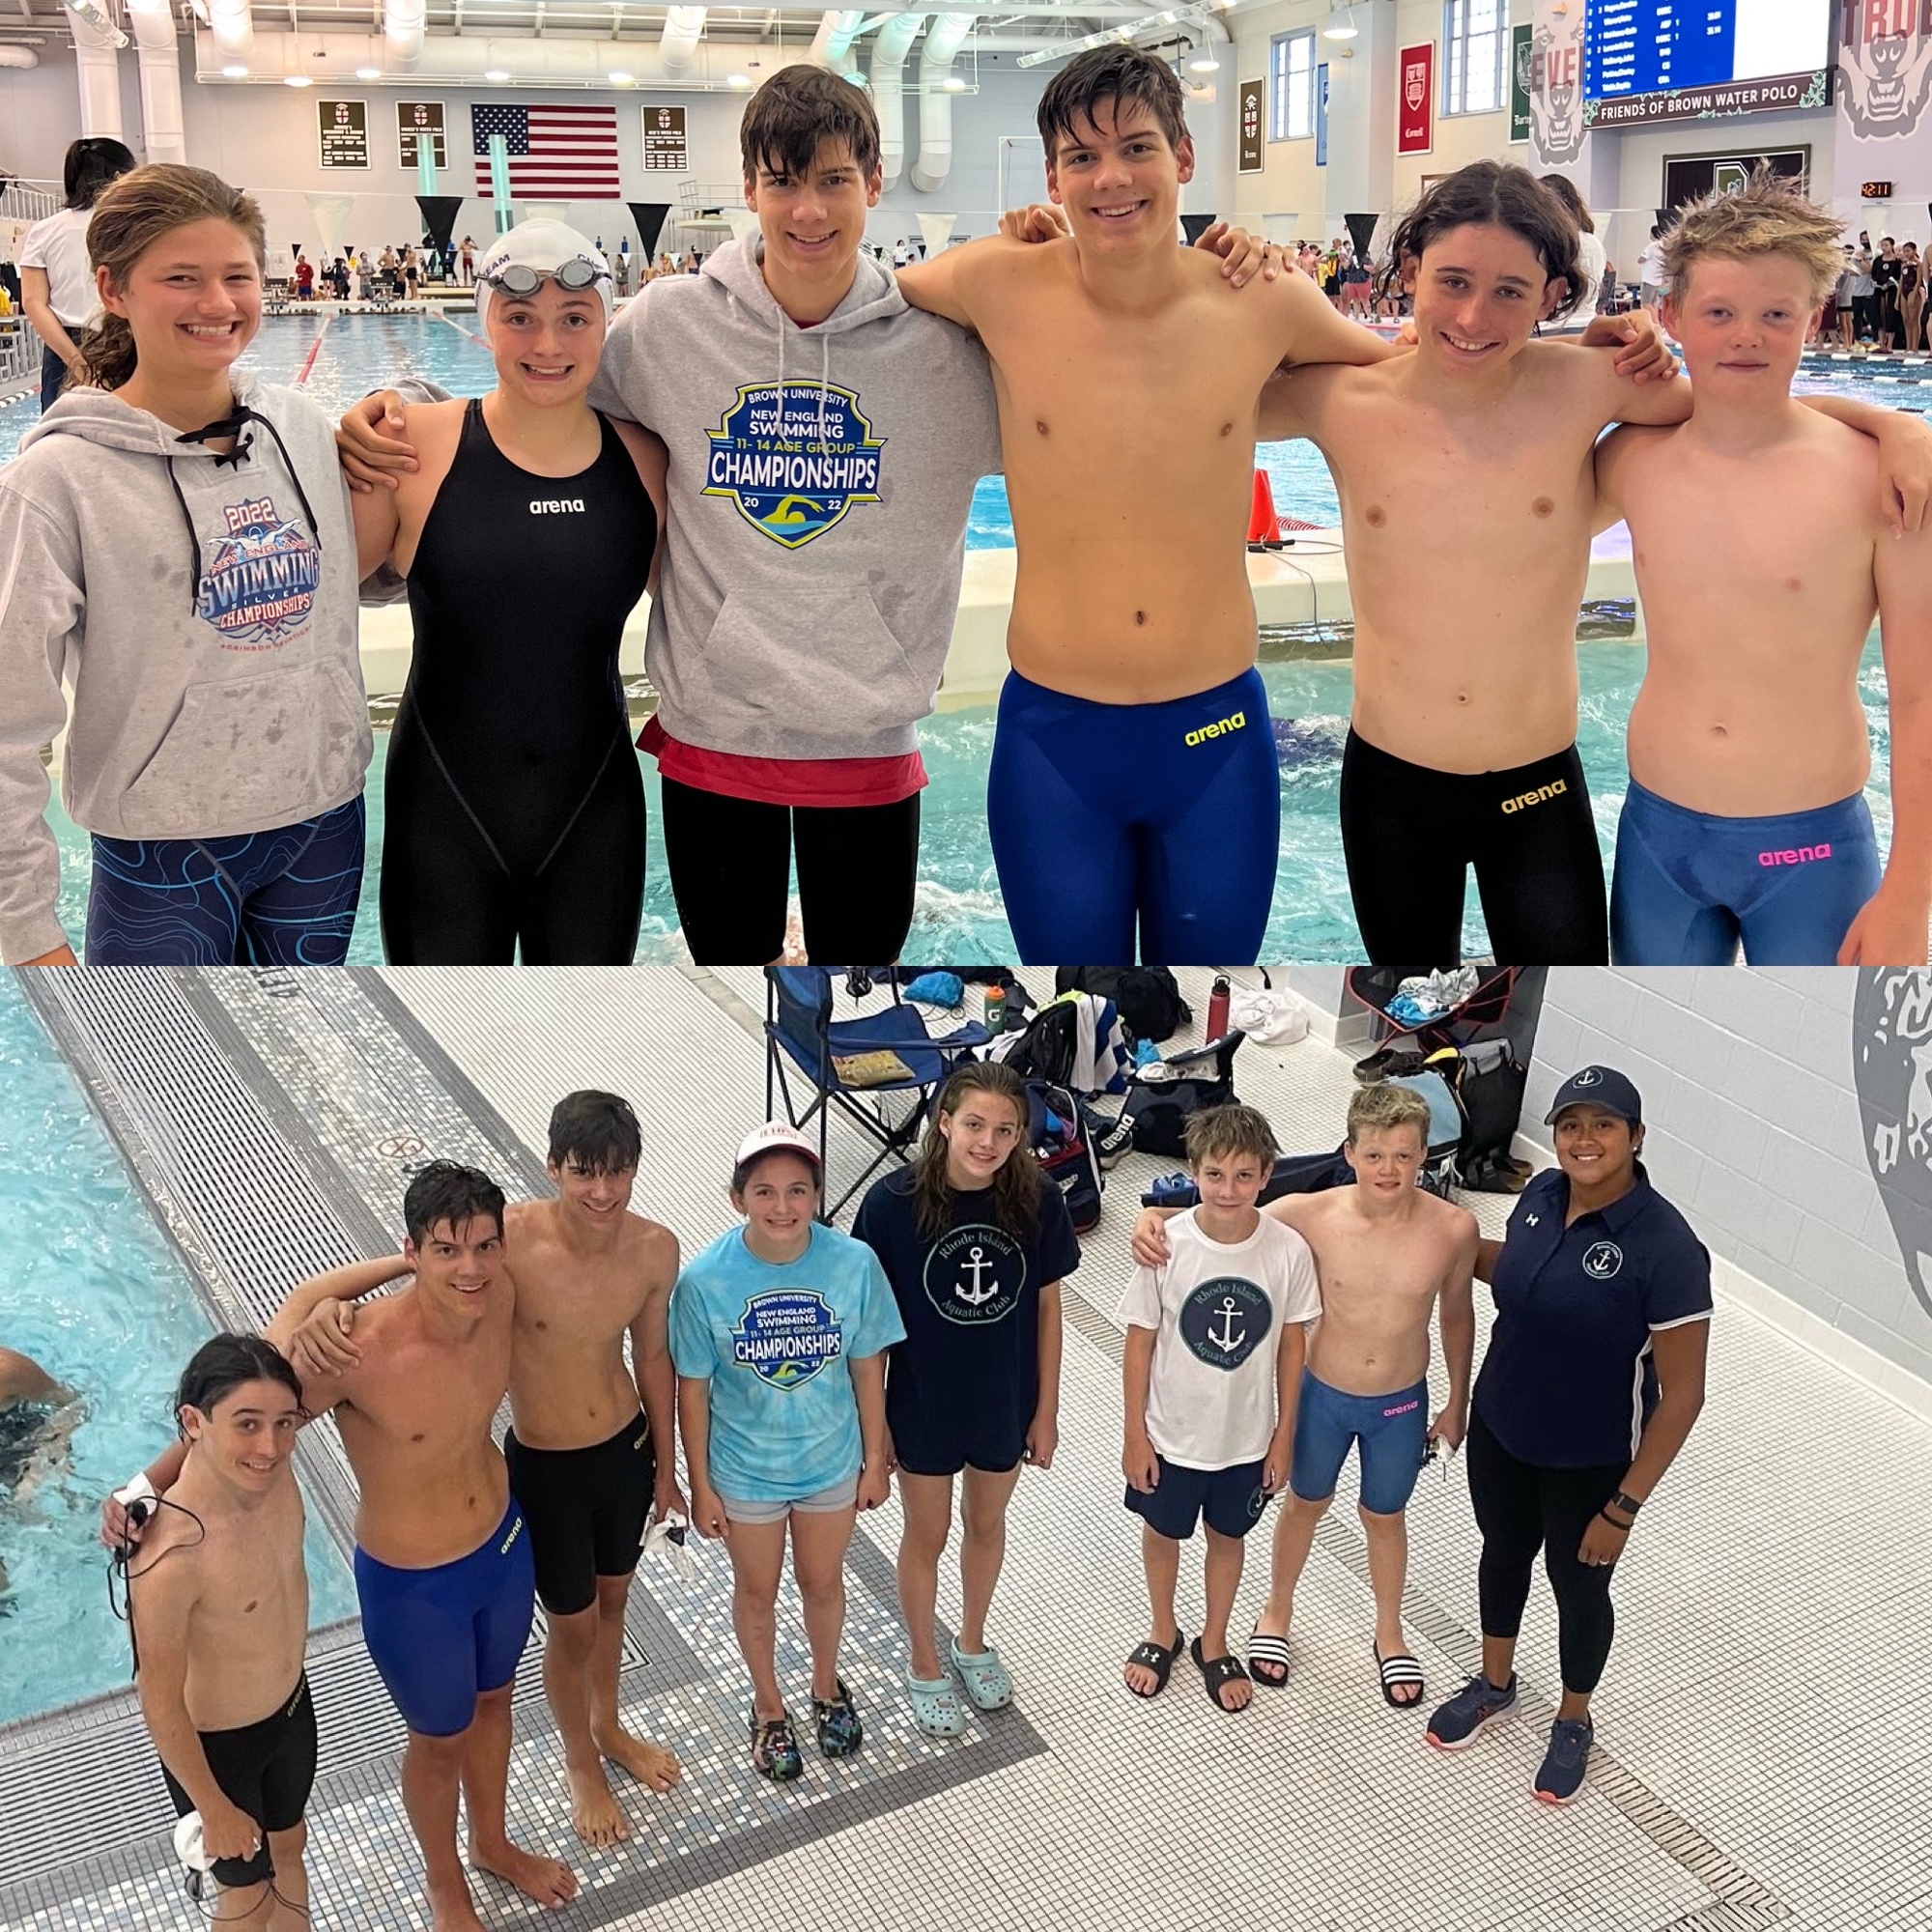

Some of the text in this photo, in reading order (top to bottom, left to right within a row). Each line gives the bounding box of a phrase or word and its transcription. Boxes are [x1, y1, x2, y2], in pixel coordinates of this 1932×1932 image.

[1601, 85, 1798, 120] FRIENDS OF BROWN WATER POLO
[751, 410, 779, 421] NEW
[774, 440, 802, 452] AGE
[711, 451, 876, 490] CHAMPIONSHIPS
[225, 497, 276, 531] 2022
[529, 498, 585, 514] arena
[744, 497, 840, 510] 20 22
[211, 539, 308, 575] NEW ENGLAND
[198, 548, 320, 619] SWIMMING
[220, 592, 311, 629] CHAMPIONSHIPS
[232, 586, 299, 611] SILVER
[1184, 711, 1246, 747] arena
[1501, 779, 1567, 813] arena
[1758, 843, 1832, 867] arena
[988, 1009, 1000, 1022] G
[1100, 1113, 1136, 1151] arena
[939, 1231, 1013, 1260] Rhode Island
[753, 1296, 779, 1308] BROWN
[941, 1294, 1010, 1318] Aquatic Club
[1194, 1283, 1264, 1306] Rhode Island
[757, 1315, 816, 1328] SWIMMING
[778, 1307, 815, 1316] ENGLAND
[793, 1325, 825, 1334] GROUP
[736, 1333, 840, 1360] CHAMPIONSHIPS
[1383, 1401, 1418, 1416] arena
[501, 1517, 522, 1554] arena
